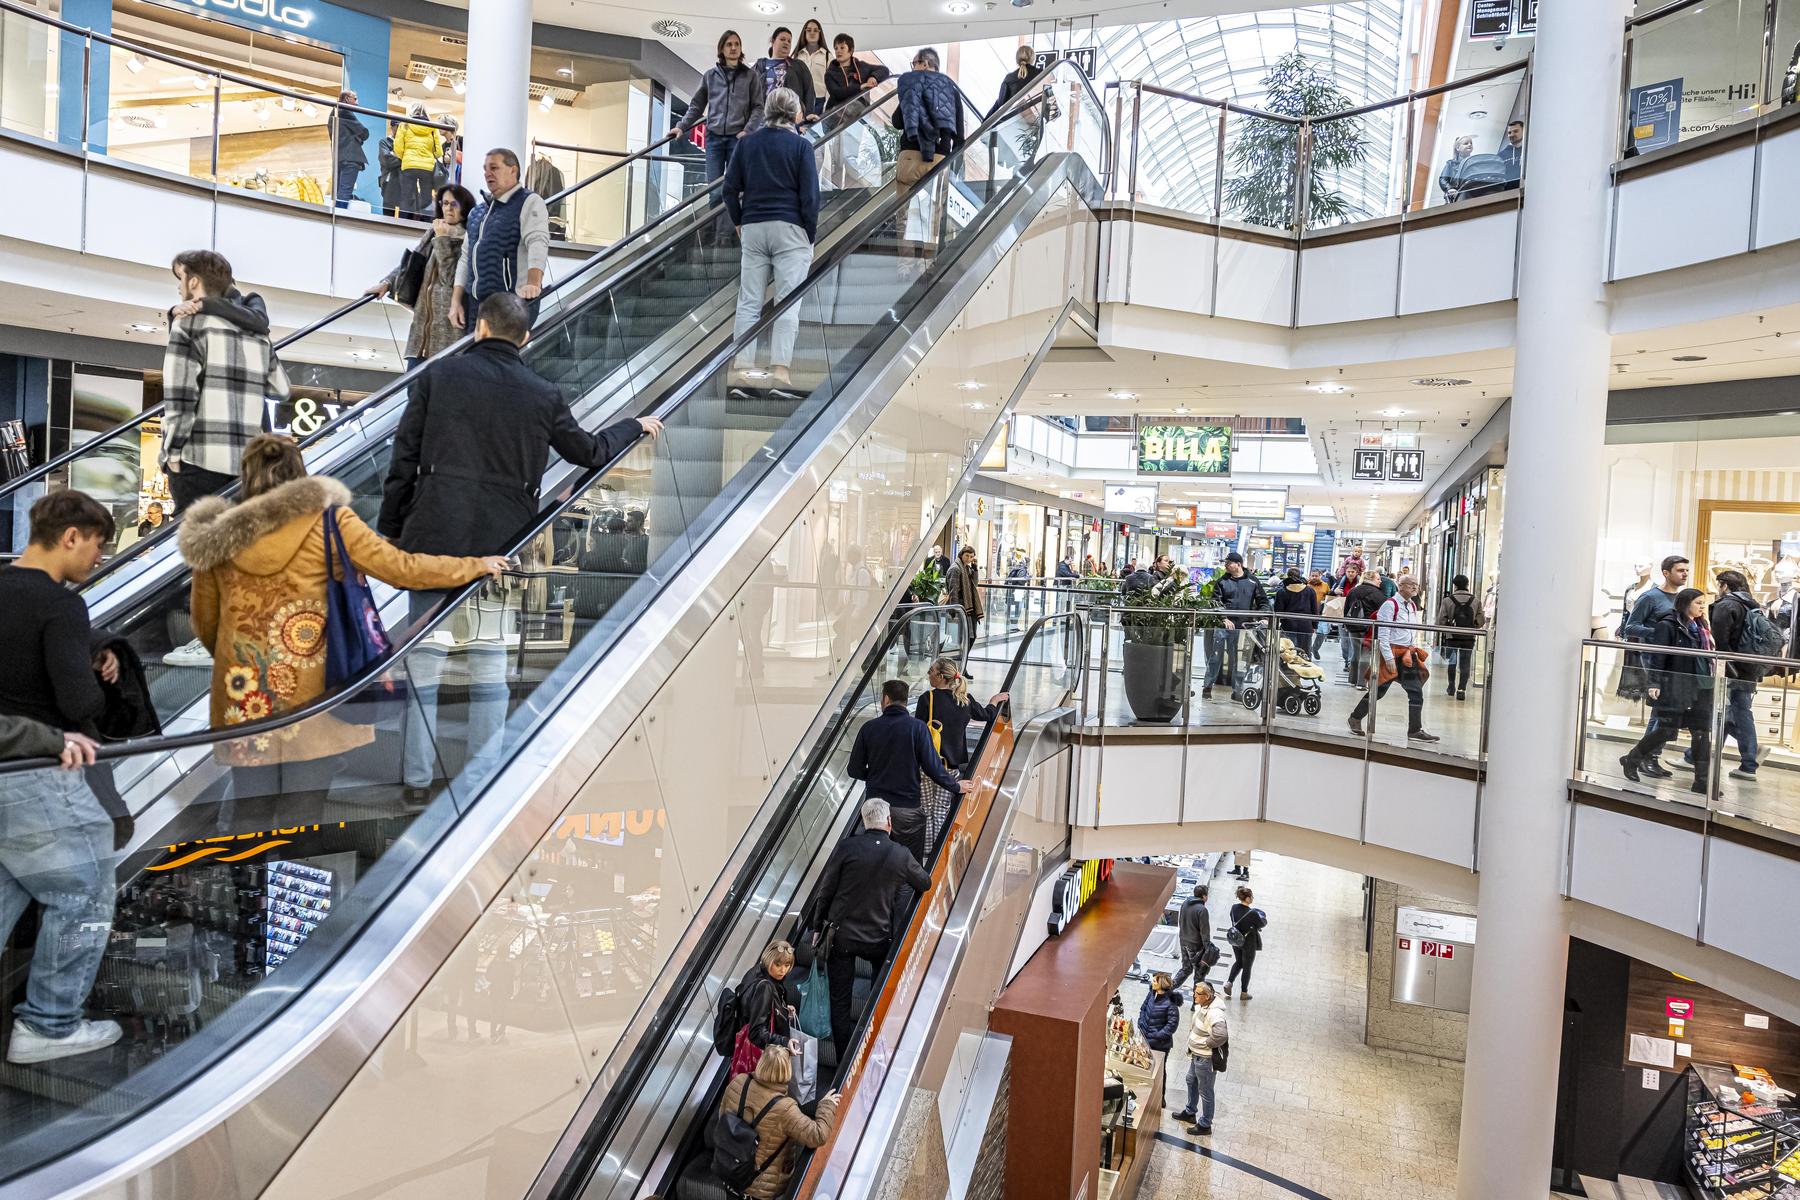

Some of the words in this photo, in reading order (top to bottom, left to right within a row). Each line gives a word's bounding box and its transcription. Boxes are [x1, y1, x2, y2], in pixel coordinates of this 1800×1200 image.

[1728, 83, 1756, 100] Hi!
[1144, 437, 1222, 461] BILLA
[1055, 859, 1100, 935] SUBWAY
